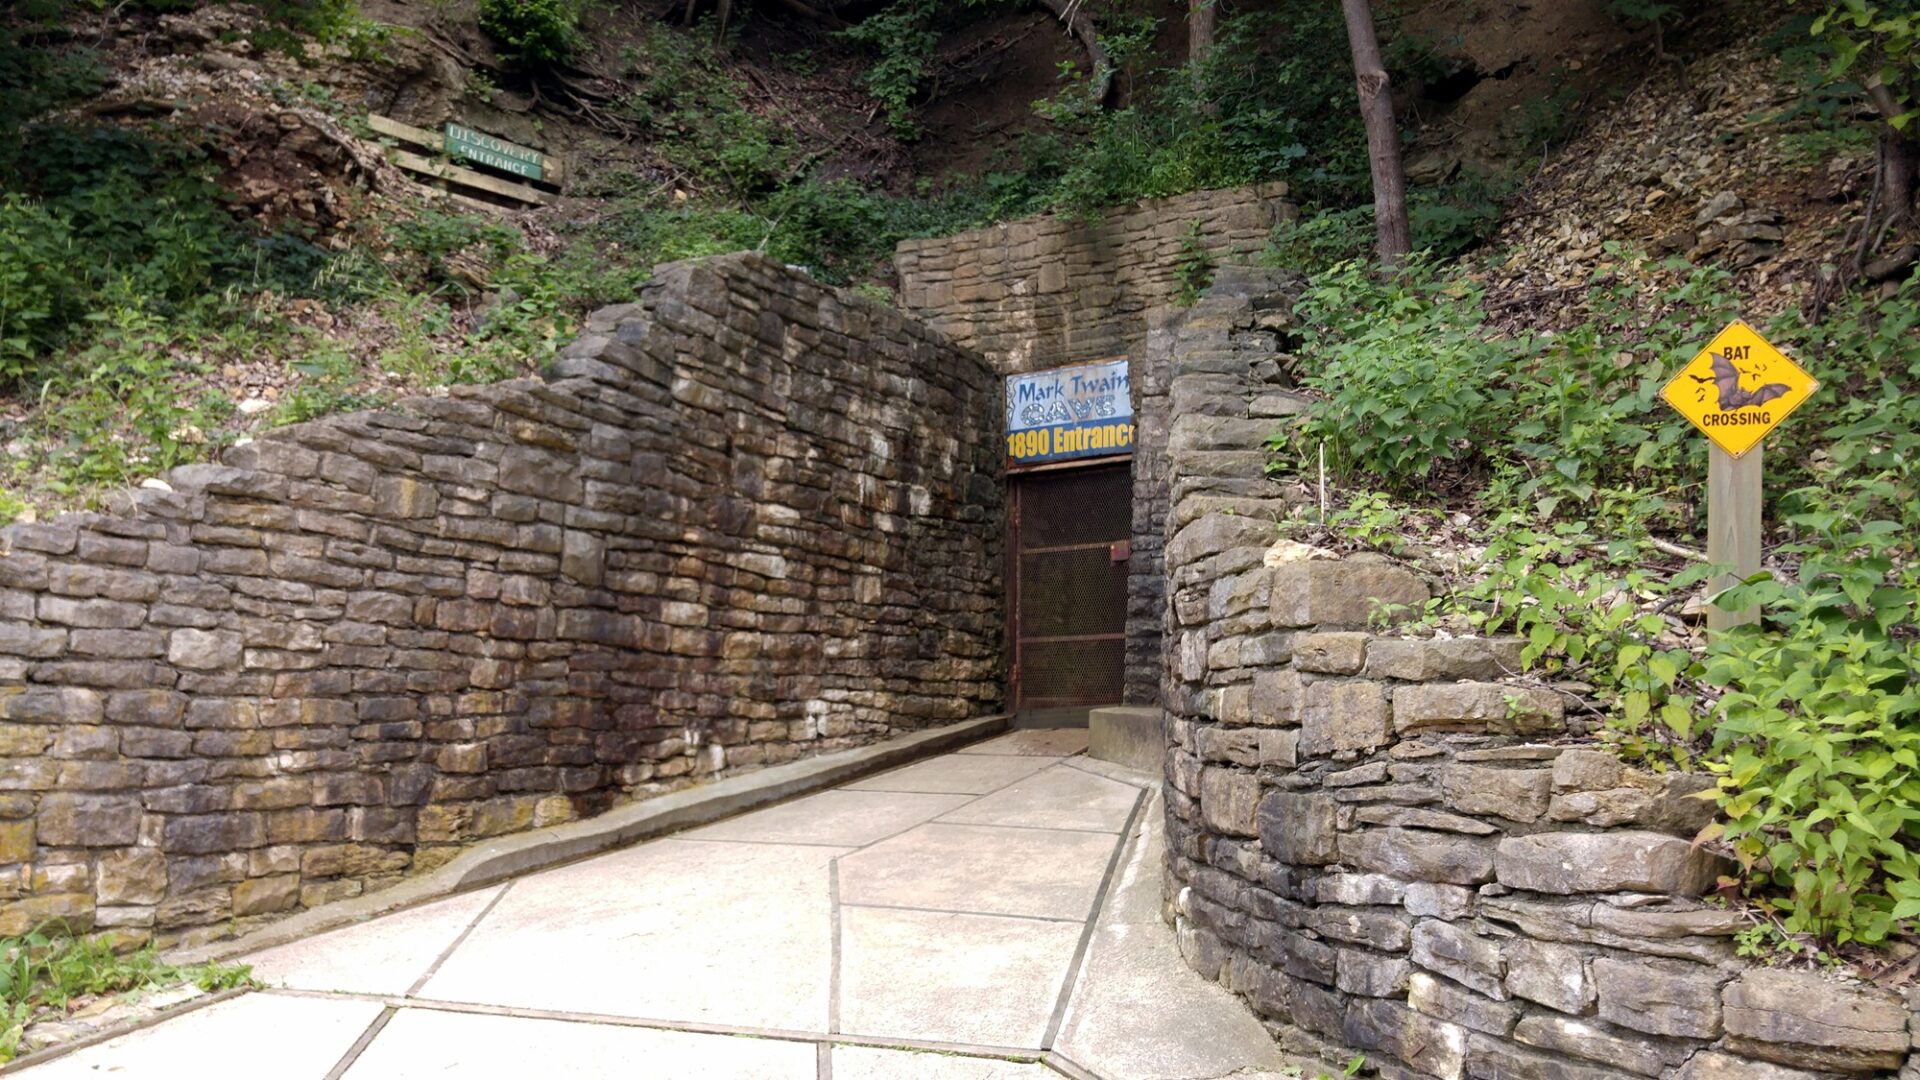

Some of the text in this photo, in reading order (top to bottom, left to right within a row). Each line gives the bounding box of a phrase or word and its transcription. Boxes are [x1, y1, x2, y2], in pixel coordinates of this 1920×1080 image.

[449, 125, 539, 164] DISCOVERY
[460, 145, 528, 175] ENTRANCE
[1723, 346, 1751, 361] BAT
[1019, 371, 1129, 403] Mark Twain
[1021, 394, 1116, 426] CAVE
[1703, 412, 1771, 426] CROSSING
[1007, 428, 1049, 458] 1890
